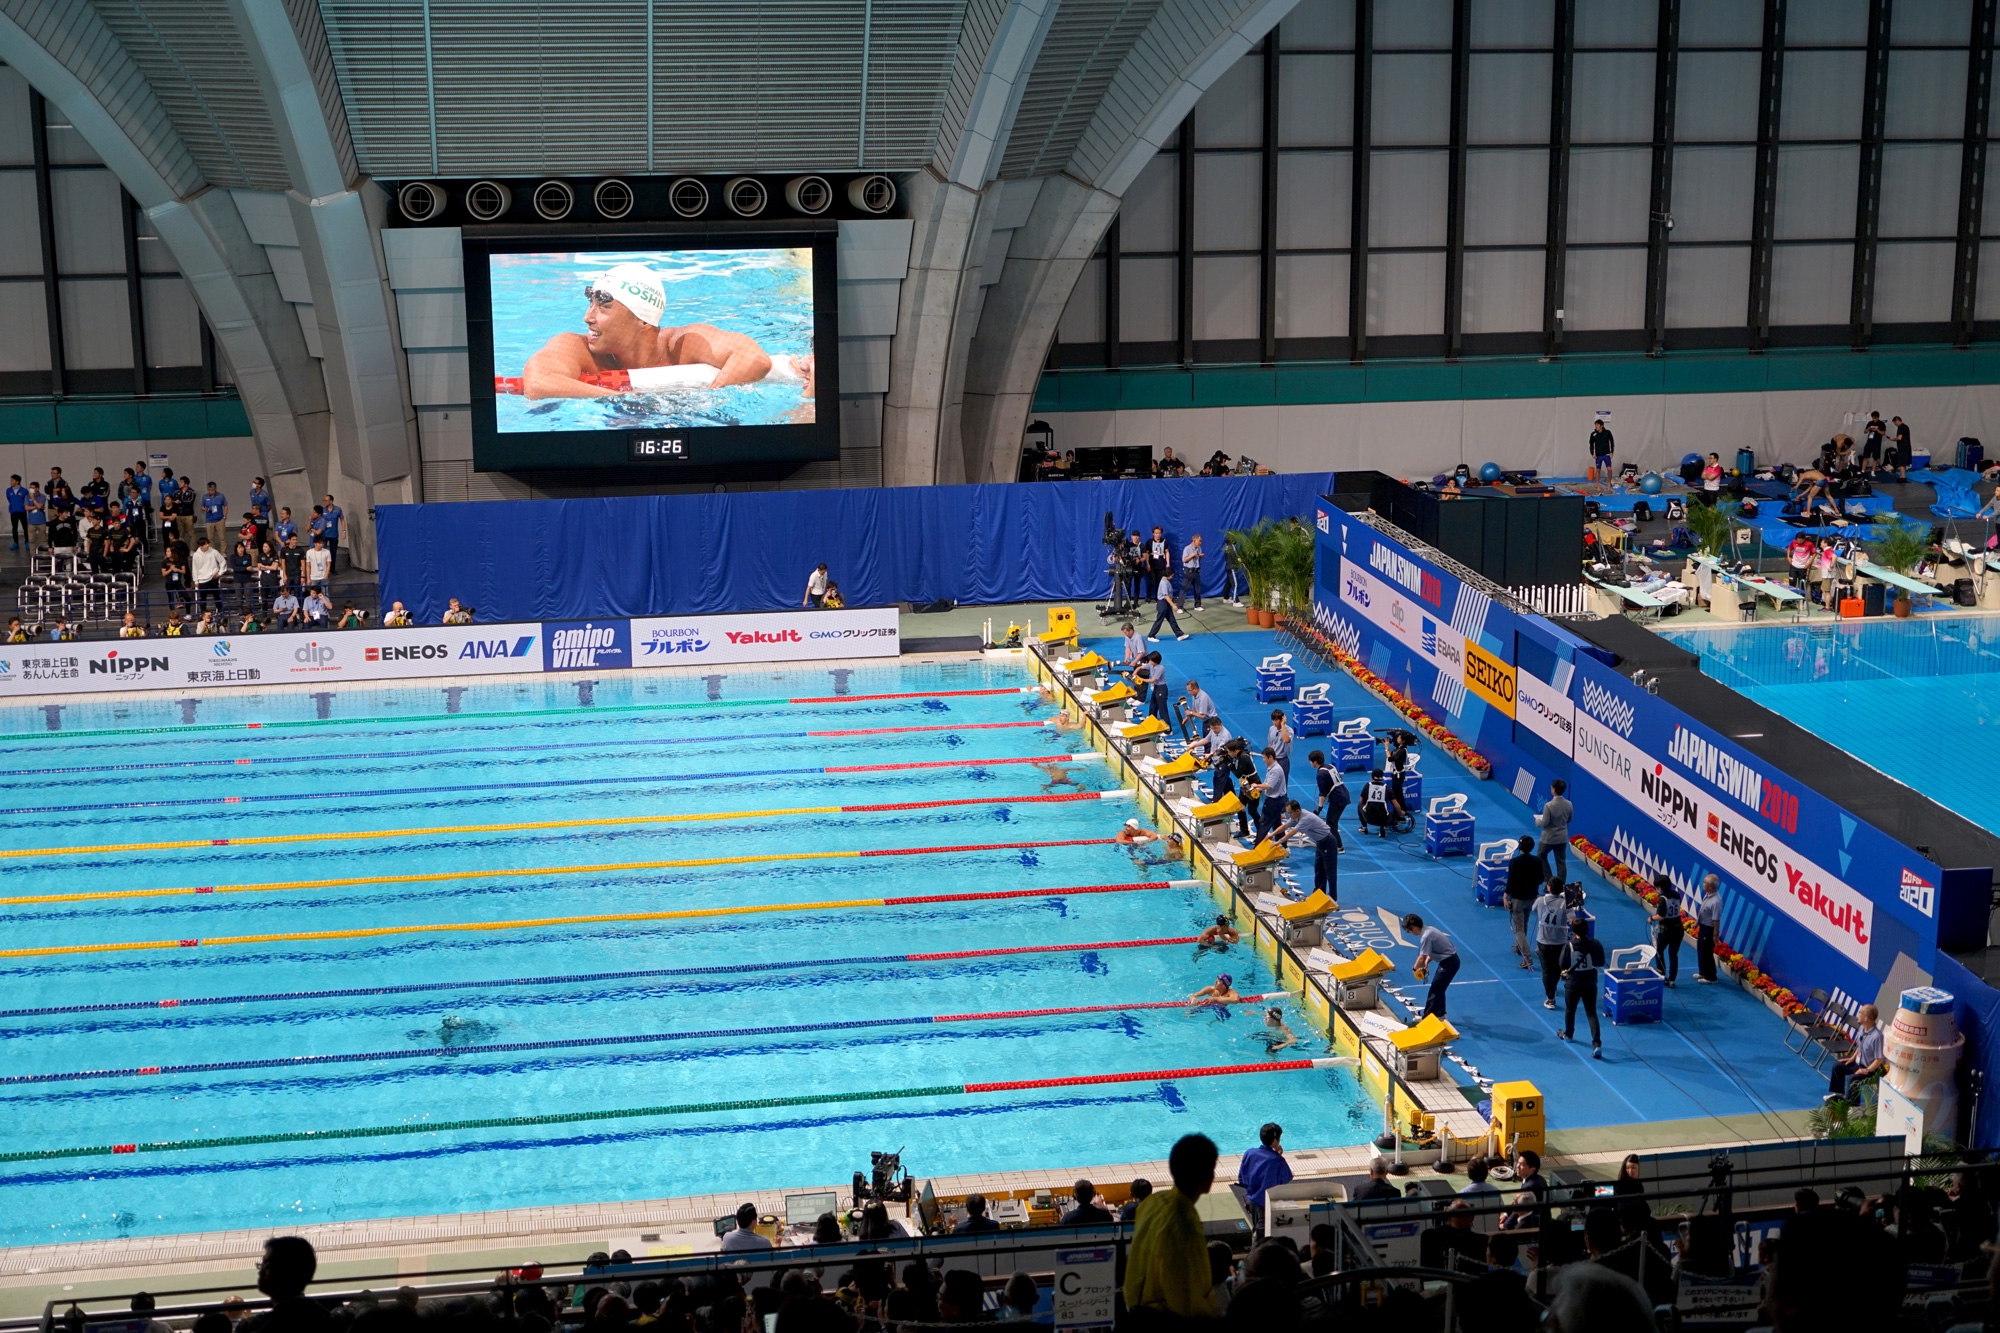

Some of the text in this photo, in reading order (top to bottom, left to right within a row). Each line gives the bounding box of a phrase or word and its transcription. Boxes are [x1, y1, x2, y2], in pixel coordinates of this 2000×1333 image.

[640, 440, 681, 454] 16:26
[552, 623, 615, 650] amino
[652, 628, 699, 638] BOURBON
[725, 629, 803, 645] Yakult
[294, 641, 335, 666] dip
[382, 644, 448, 661] ENEOS
[458, 640, 509, 660] ANA
[640, 639, 711, 656] ブルボン
[1437, 638, 1461, 667] EBARA
[22, 658, 79, 669] 東京海上日動
[22, 668, 80, 680] あんしん生命
[187, 668, 261, 682] 東京海上日動
[1466, 651, 1514, 703] SEIKO
[1578, 727, 1631, 782] SUNSTAR
[1371, 791, 1382, 801] 43
[1720, 821, 1778, 883] ENEOS
[1784, 861, 1868, 945] Yakult
[1900, 884, 1935, 919] 2020
[1545, 914, 1557, 926] 44
[1060, 1272, 1112, 1296] C ブロック
[1096, 1309, 1108, 1317] 93
